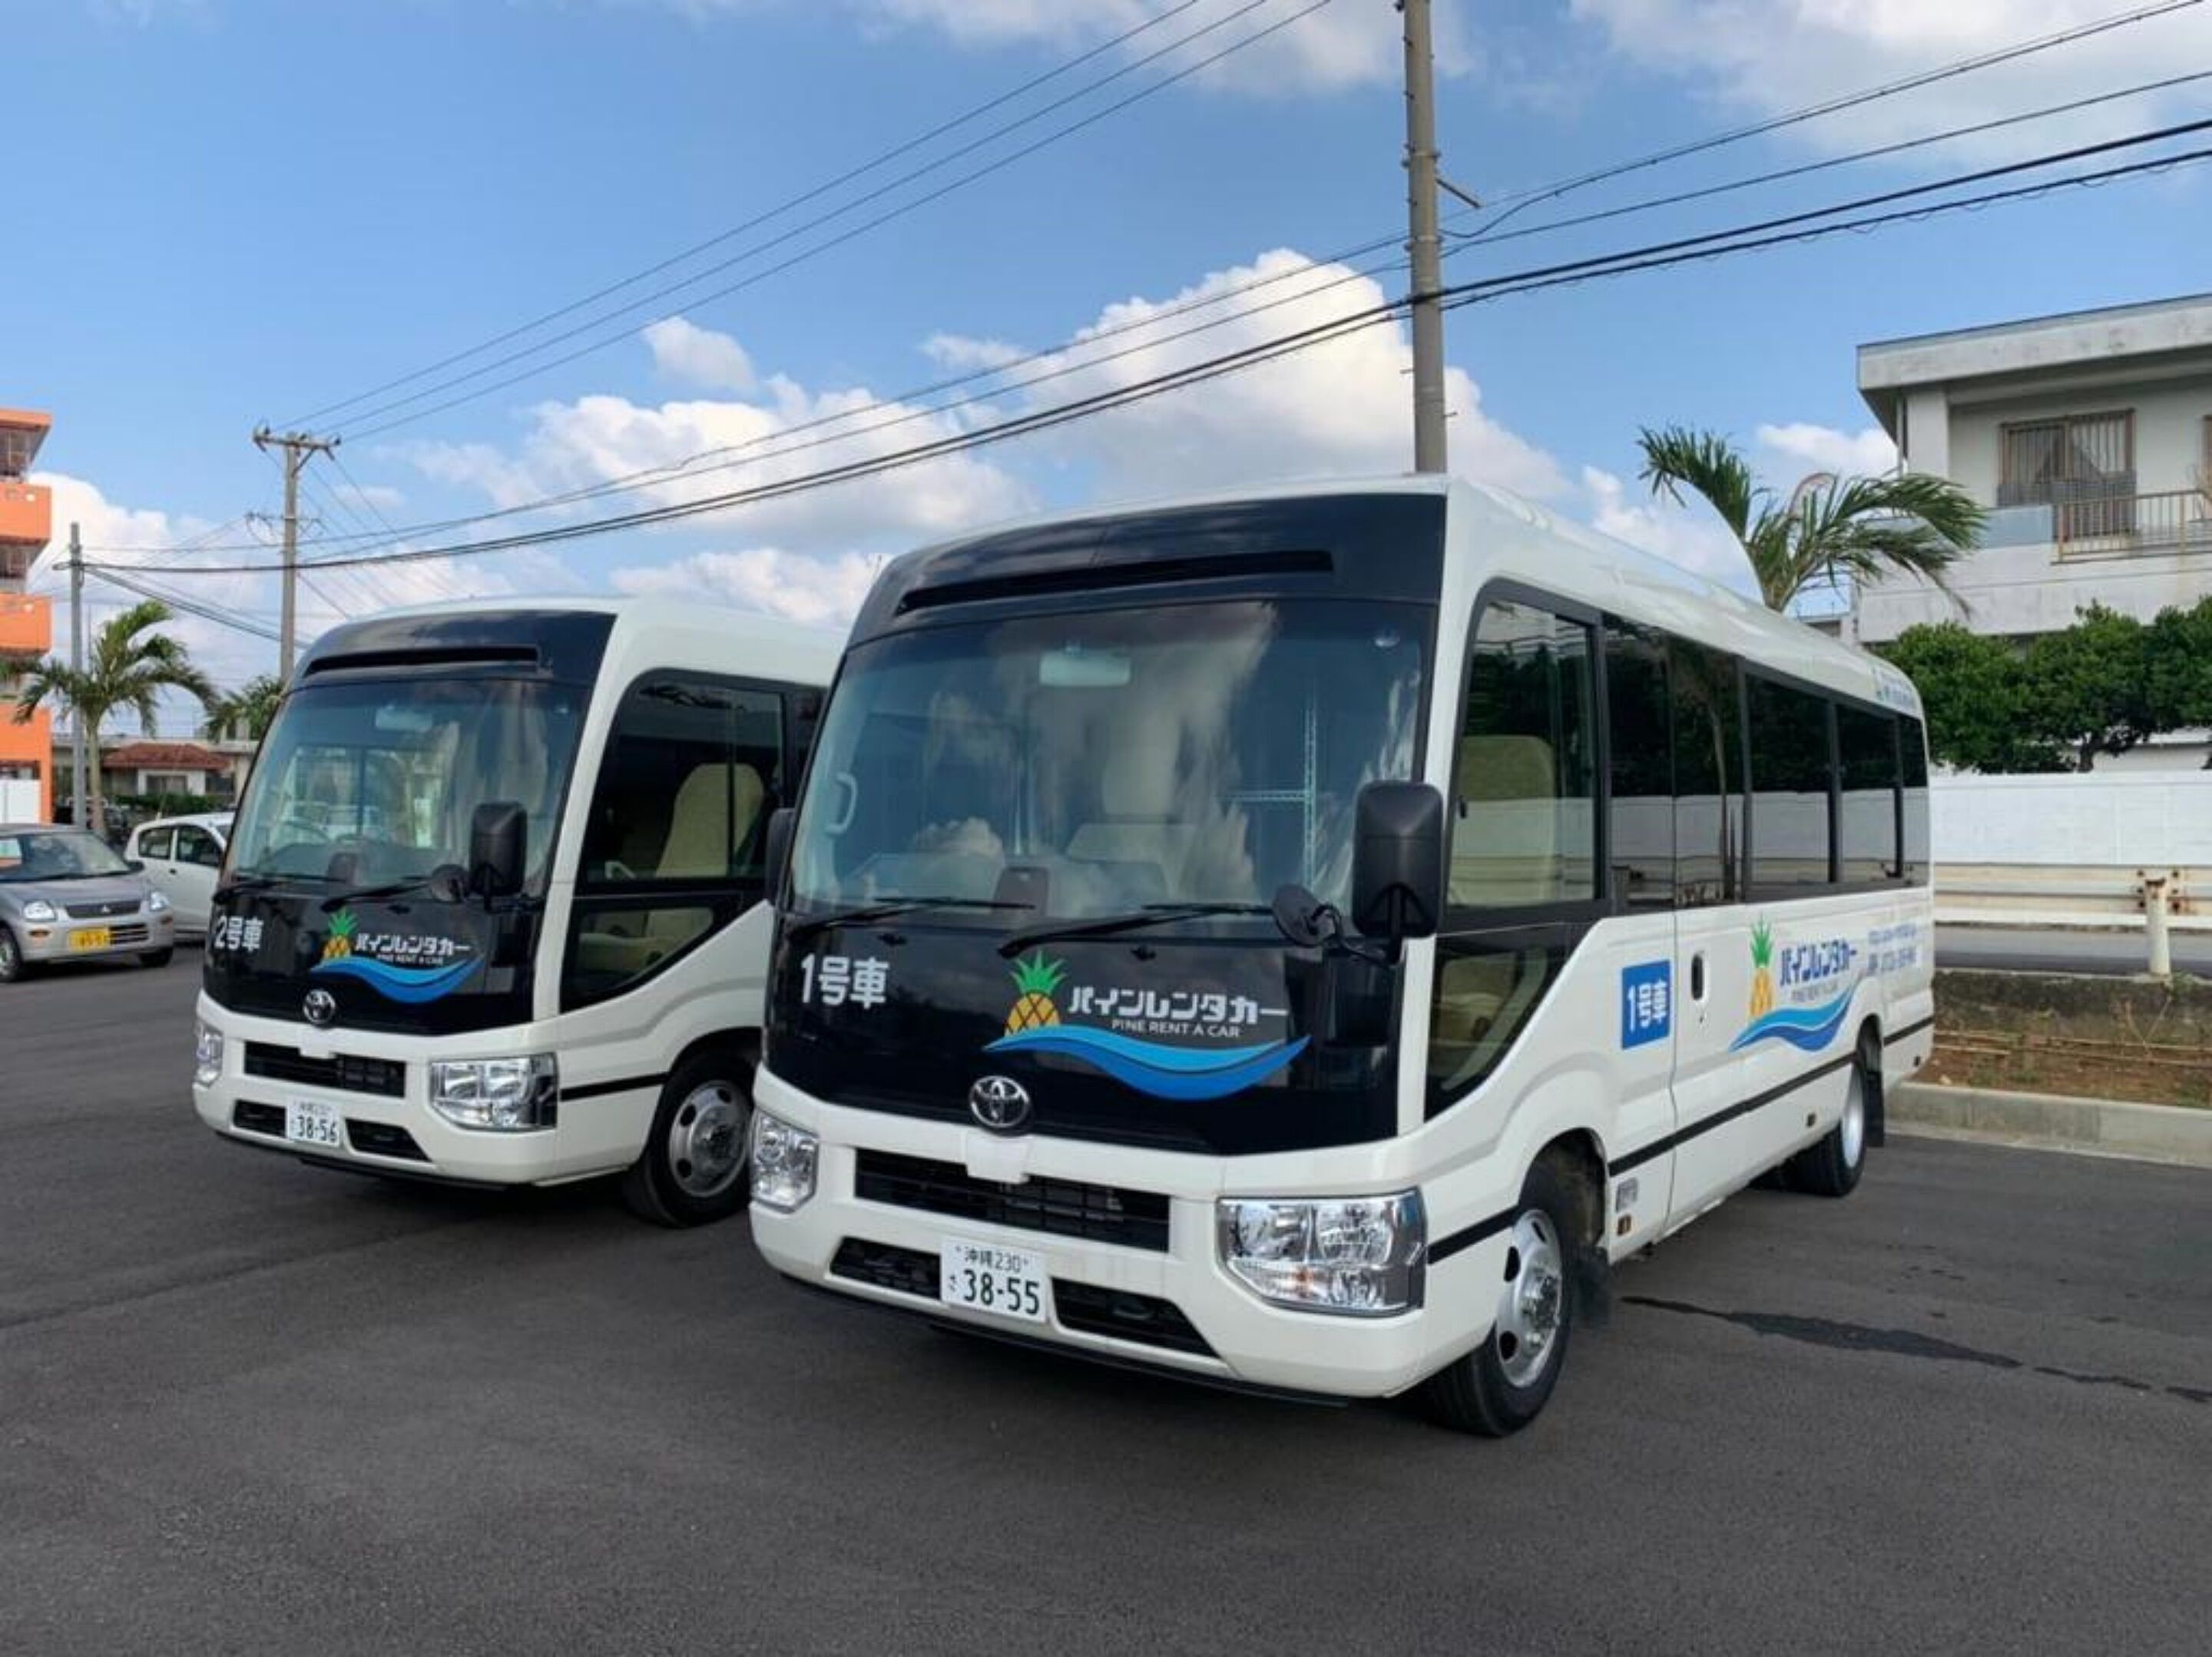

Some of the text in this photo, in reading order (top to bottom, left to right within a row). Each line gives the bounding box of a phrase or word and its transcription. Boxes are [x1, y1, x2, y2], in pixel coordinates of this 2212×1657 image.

[214, 915, 264, 952] 2号車
[355, 933, 471, 956] パインレンタカー
[801, 953, 890, 1009] 1号車
[1068, 986, 1288, 1025] パインレンタカー
[1628, 977, 1667, 1032] 1号車
[1112, 1019, 1241, 1038] PINE RENT A CAR
[963, 1268, 1040, 1315] 38-55
